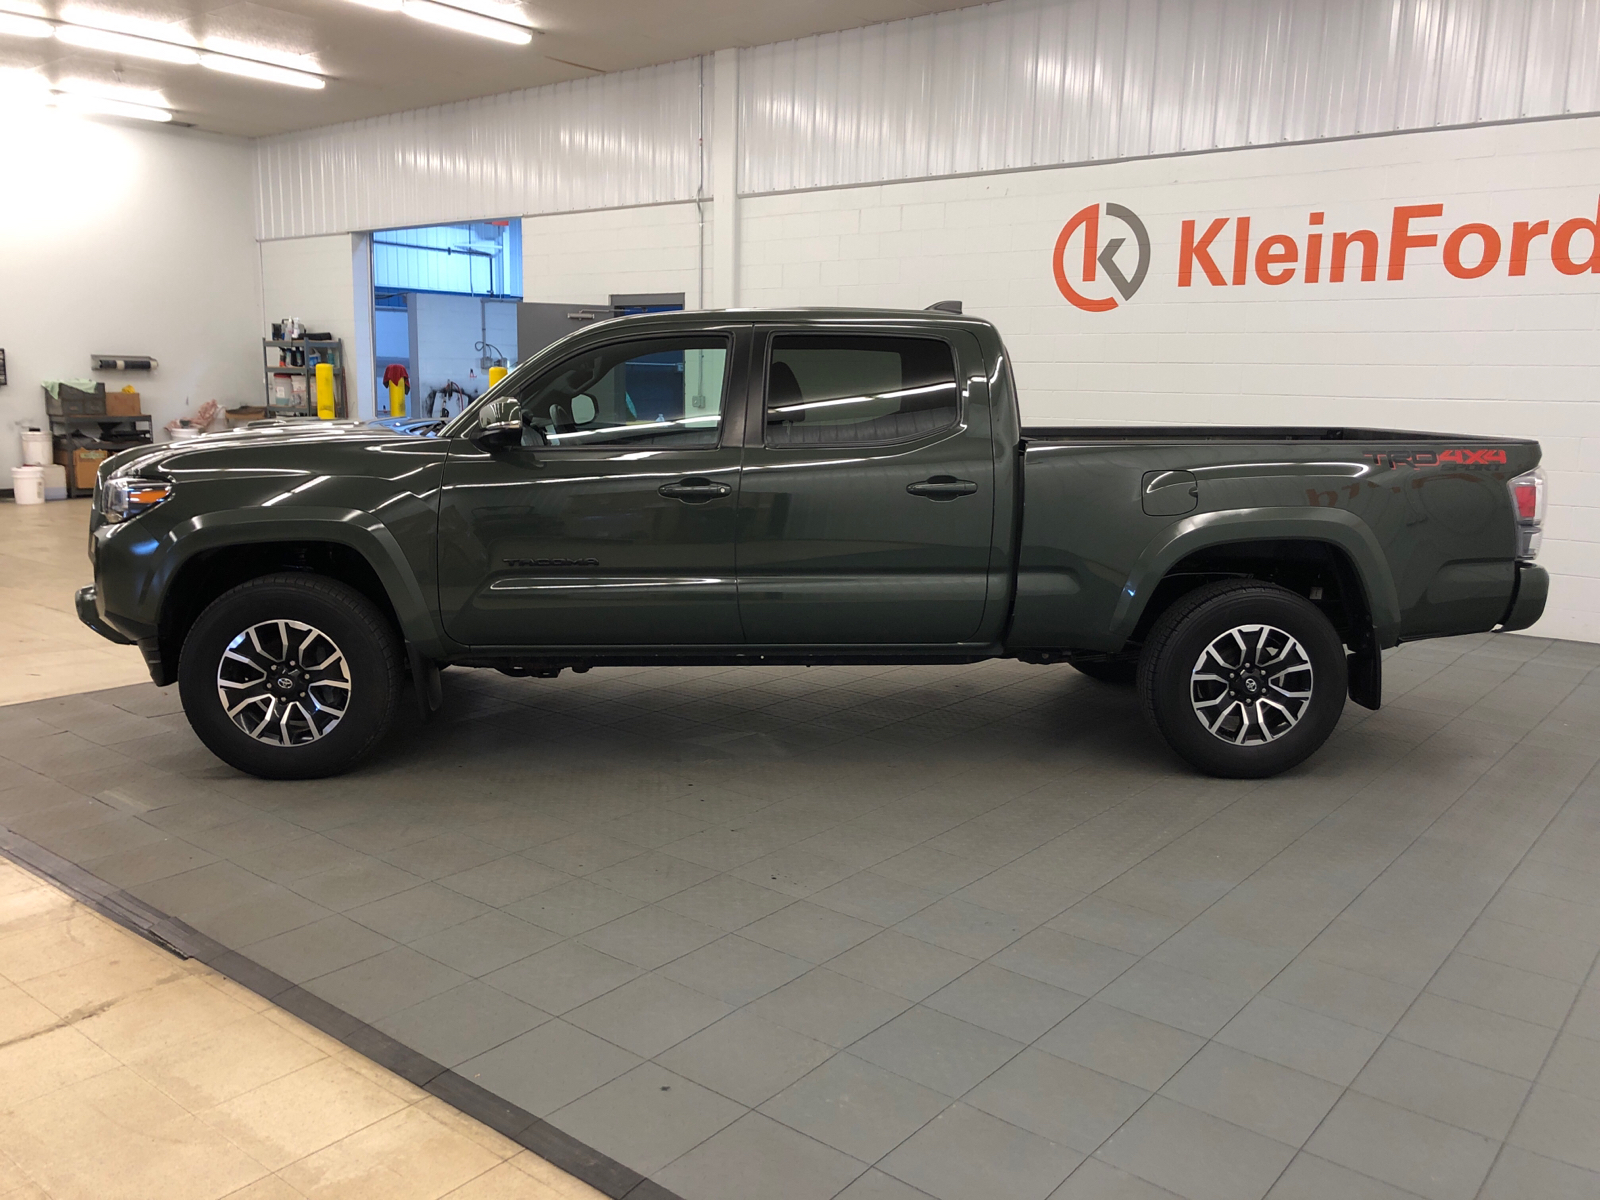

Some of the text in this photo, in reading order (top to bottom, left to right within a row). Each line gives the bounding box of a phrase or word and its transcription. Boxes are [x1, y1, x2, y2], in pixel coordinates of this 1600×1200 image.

[1177, 193, 1600, 288] KleinFord
[1362, 450, 1440, 470] TRD
[503, 557, 600, 567] TACOMA
